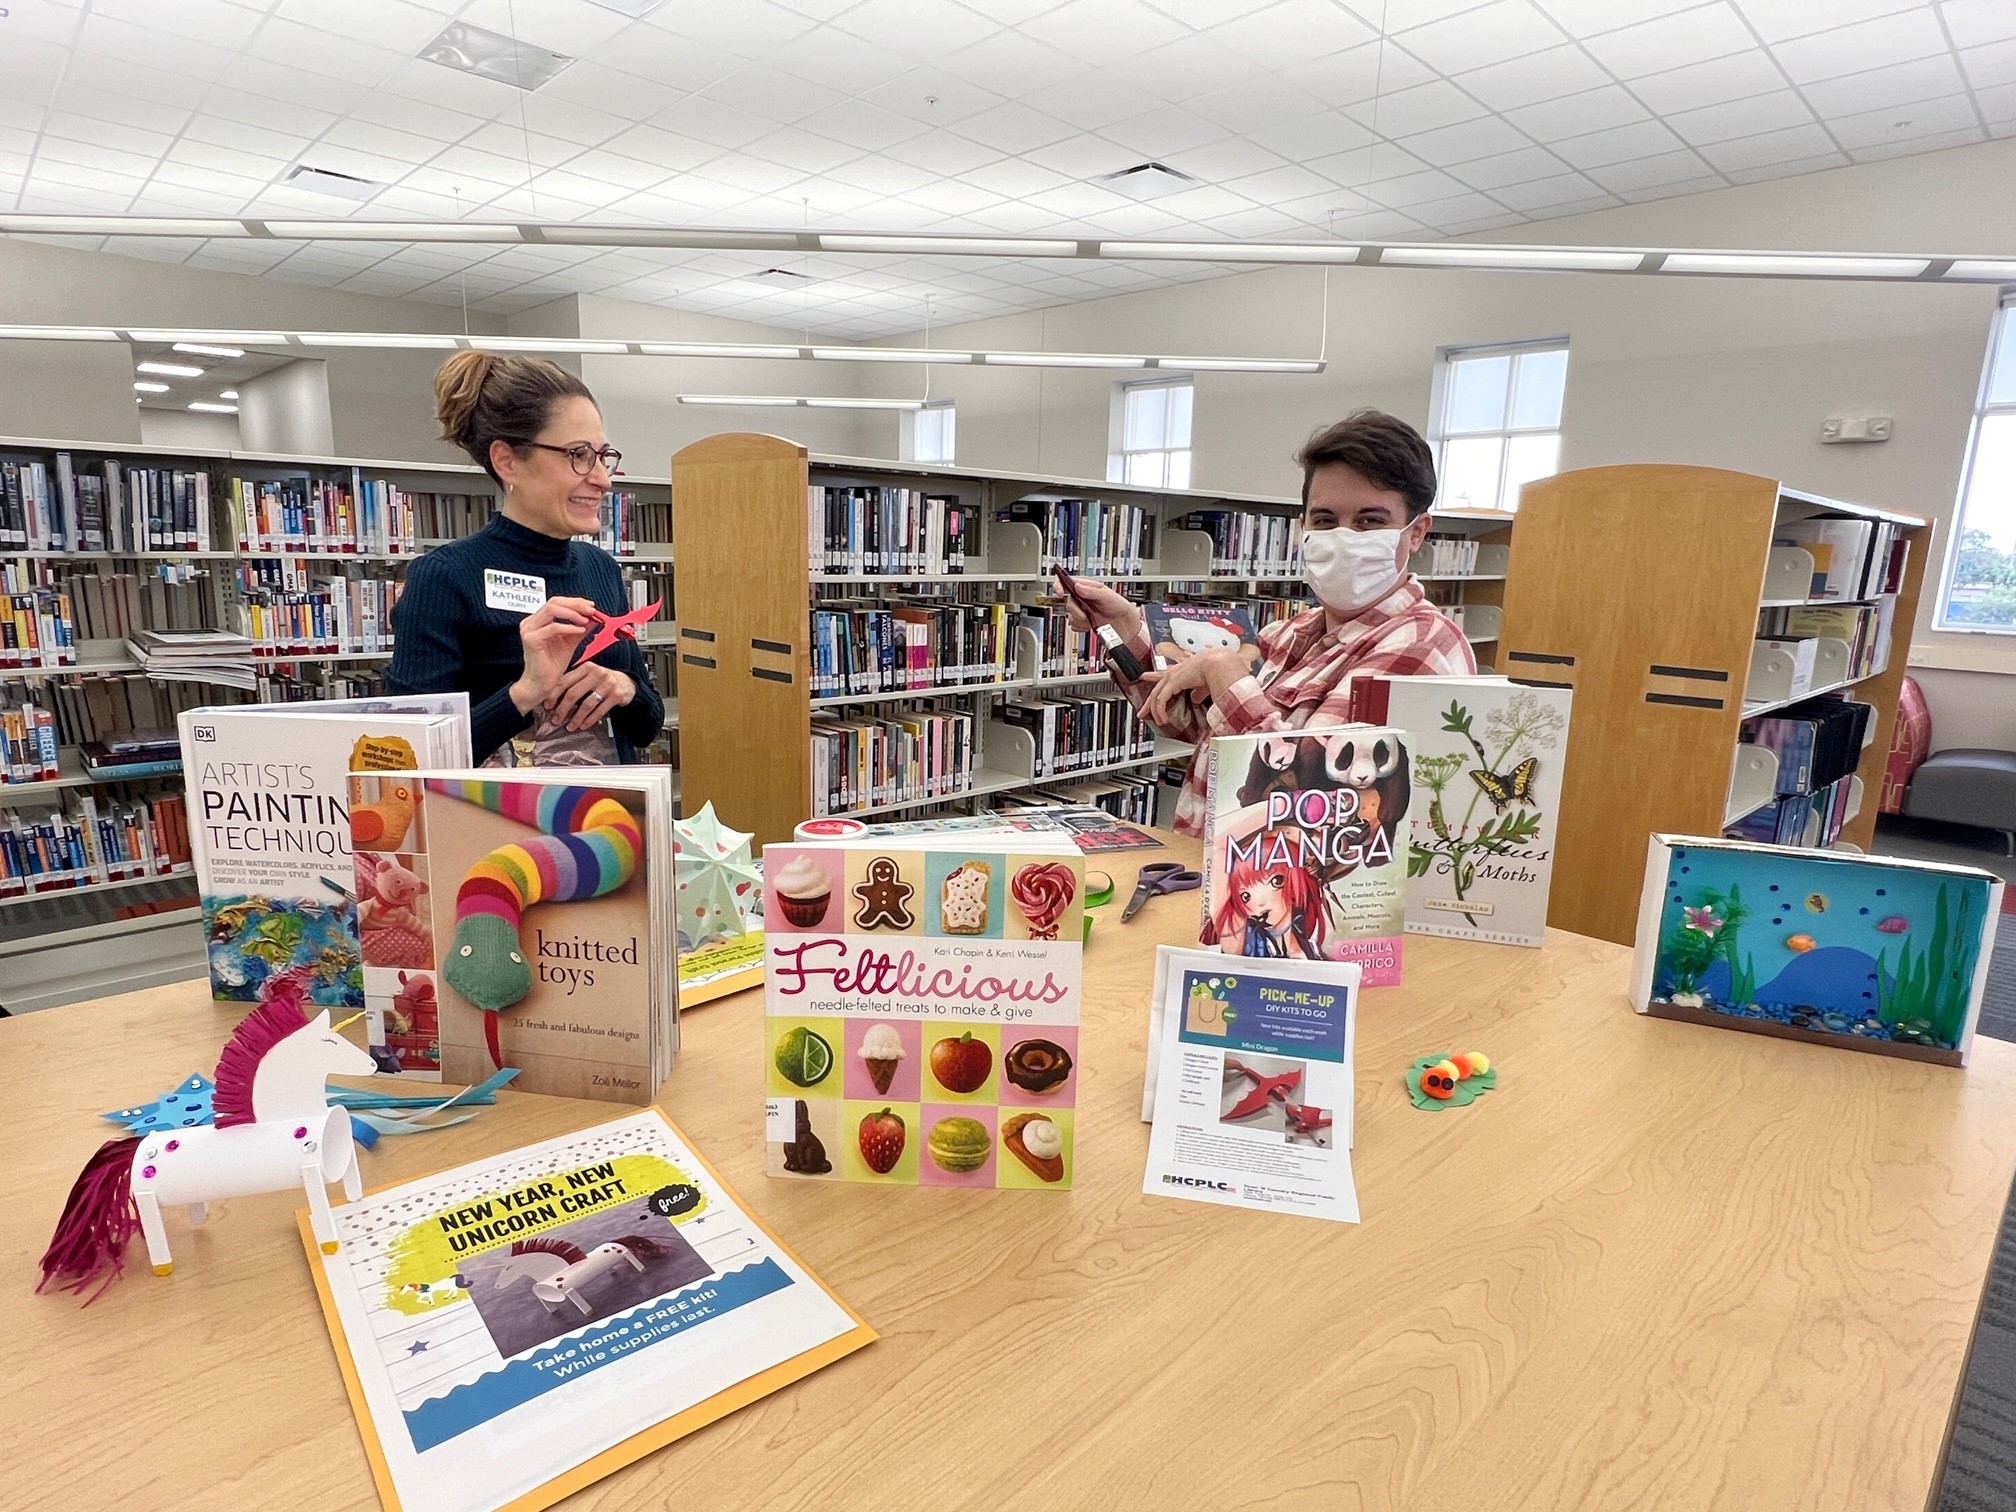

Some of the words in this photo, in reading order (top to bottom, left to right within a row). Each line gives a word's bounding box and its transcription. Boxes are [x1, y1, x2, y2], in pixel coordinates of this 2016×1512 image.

[494, 574, 537, 589] HCPLC
[492, 591, 540, 604] KATHLEEN
[38, 726, 55, 760] GREECE
[197, 729, 213, 739] DK
[1210, 750, 1219, 783] POP
[203, 790, 349, 826] PAINTIN
[1204, 789, 1218, 848] MANGA
[1266, 788, 1361, 831] POP
[207, 826, 352, 857] TECHNIQU
[1223, 823, 1395, 874] MANGA
[211, 858, 244, 867] EXPLORE
[337, 864, 353, 873] AND
[212, 867, 247, 876] DISCOVER
[248, 869, 268, 877] YOUR
[269, 870, 287, 878] OWN
[288, 871, 311, 879] STYLE
[1477, 865, 1537, 883] Moths
[213, 876, 236, 884] GROW
[260, 878, 285, 887] ARTIST
[536, 929, 639, 965] knitted
[934, 947, 951, 956] Kari
[953, 948, 984, 958] Chapin
[986, 949, 994, 957] &
[1017, 950, 1047, 959] Wessel
[1340, 942, 1393, 956] CAMILLA
[538, 961, 595, 996] toys
[774, 939, 1068, 1004] Feltlicious
[1259, 988, 1335, 1007] PICK-ME-UP
[810, 998, 891, 1012] needle-felted
[896, 1001, 930, 1014] treats
[934, 1003, 947, 1014] to
[951, 1003, 986, 1016] make
[990, 1005, 1001, 1017] &
[1005, 1005, 1033, 1021] give
[1266, 1004, 1280, 1012] DIY
[1281, 1006, 1300, 1015] KITS
[1313, 1010, 1327, 1018] GO
[513, 1019, 524, 1028] 25
[526, 1019, 548, 1030] fresh
[550, 1023, 566, 1031] and
[569, 1023, 606, 1036] fabulous
[608, 1028, 640, 1042] designs
[1256, 1043, 1278, 1052] Dragon
[613, 1077, 640, 1089] Mellor
[1171, 1175, 1228, 1191] HCPLC
[439, 1203, 493, 1233] NEW
[496, 1182, 565, 1212] YEAR,
[565, 1162, 615, 1190] NEW
[658, 1188, 690, 1213] free!
[448, 1204, 558, 1252] UNICORN
[561, 1179, 627, 1213] CRAFT
[533, 1349, 577, 1371] Take
[579, 1327, 630, 1352] home
[633, 1321, 644, 1330] a
[646, 1301, 690, 1324] FREE
[691, 1288, 718, 1305] kit!
[553, 1352, 606, 1378] While
[610, 1319, 680, 1354] supplies
[681, 1306, 716, 1324] last.
